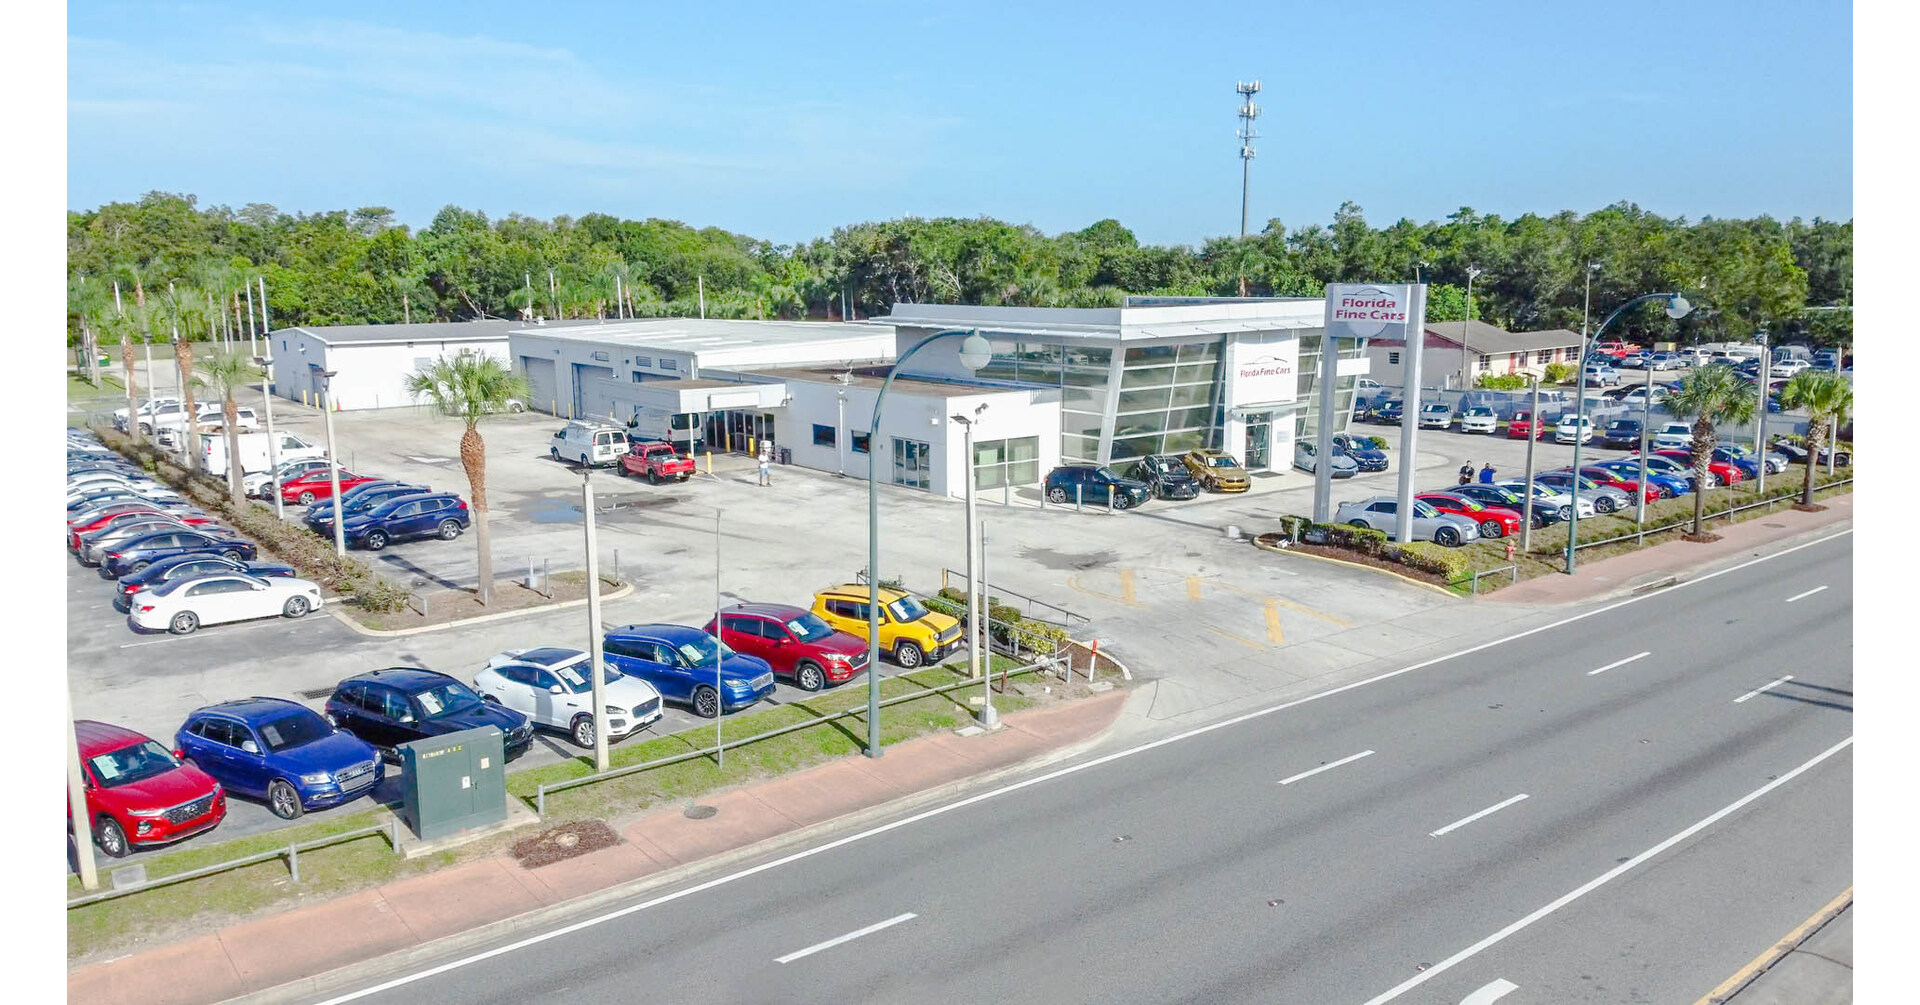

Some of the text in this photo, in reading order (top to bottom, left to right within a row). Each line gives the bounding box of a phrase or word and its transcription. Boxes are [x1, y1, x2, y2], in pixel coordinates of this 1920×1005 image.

[1342, 298, 1396, 308] Florida
[1336, 309, 1405, 320] Fine Cars
[1240, 366, 1291, 378] Florida Fine Cars
